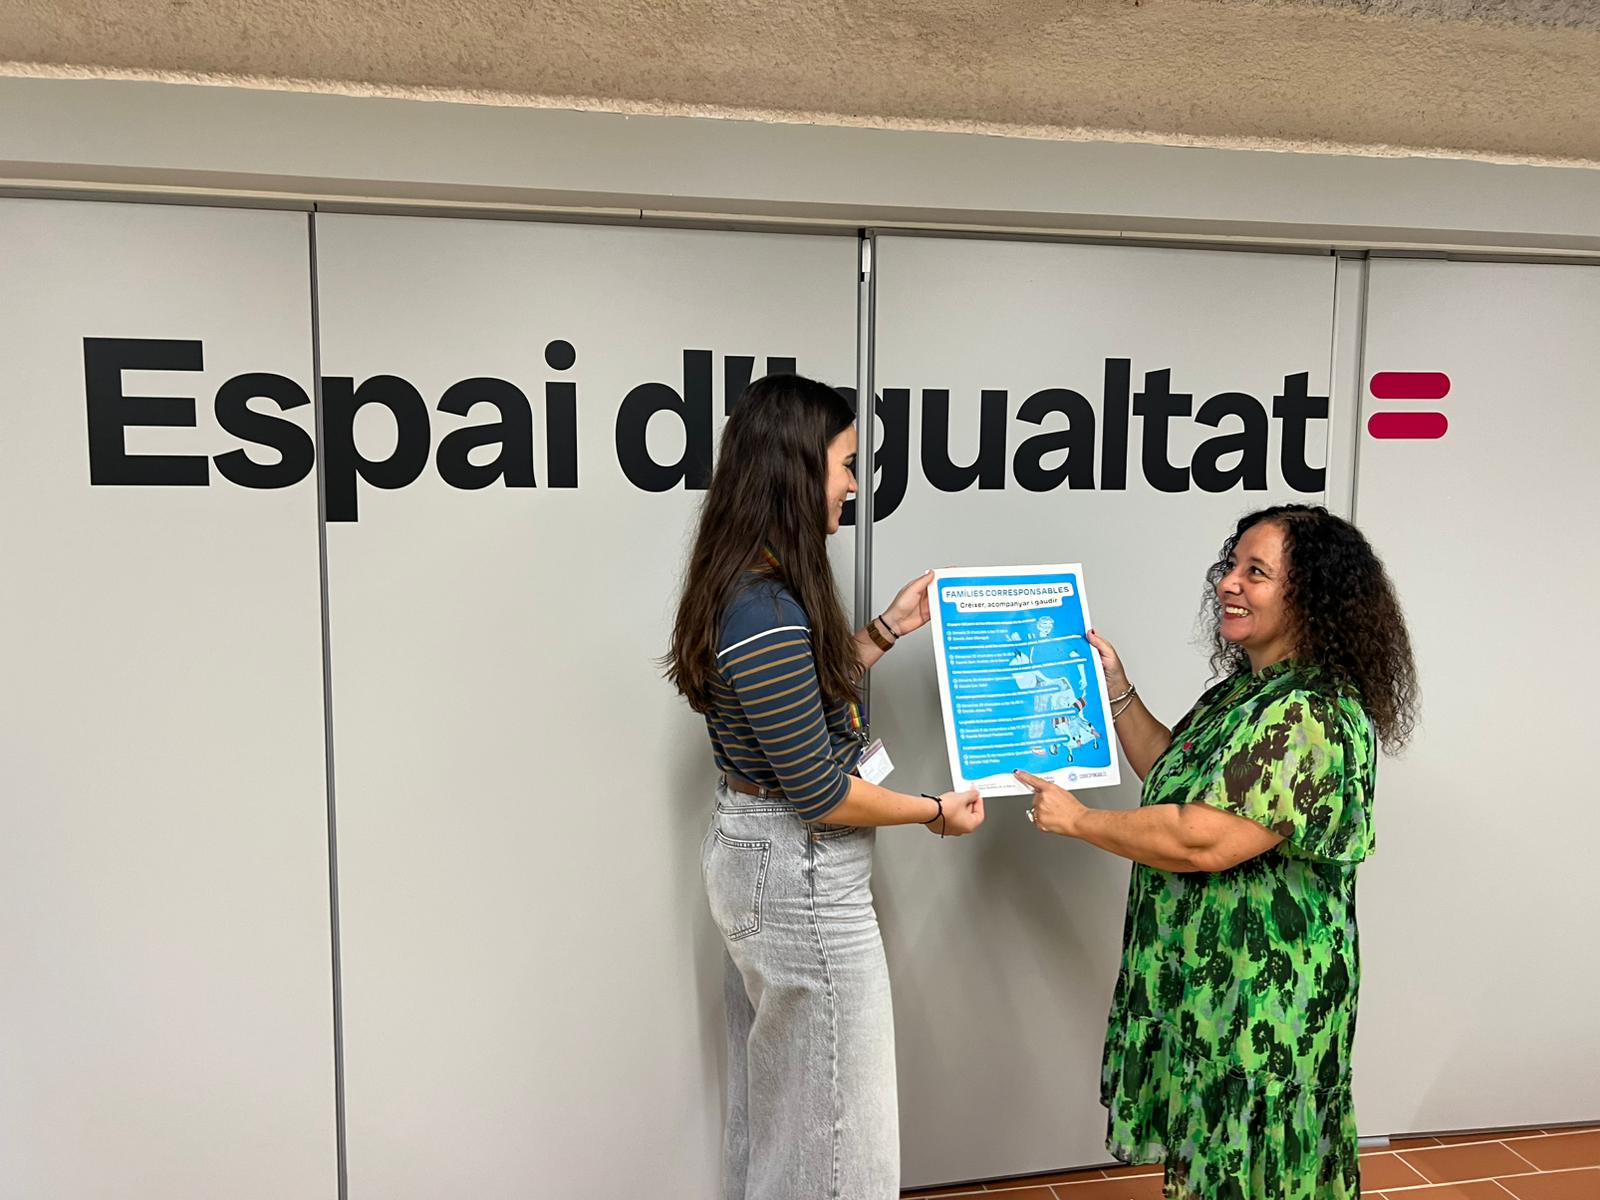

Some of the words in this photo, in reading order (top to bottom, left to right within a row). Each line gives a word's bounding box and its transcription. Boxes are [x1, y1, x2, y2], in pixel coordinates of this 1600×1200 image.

[83, 337, 579, 522] Espai
[615, 350, 1329, 526] d'gualtat
[985, 586, 1070, 597] CORRESPONSABLES
[987, 600, 1030, 609] acompanyar
[1035, 598, 1058, 607] gaudir
